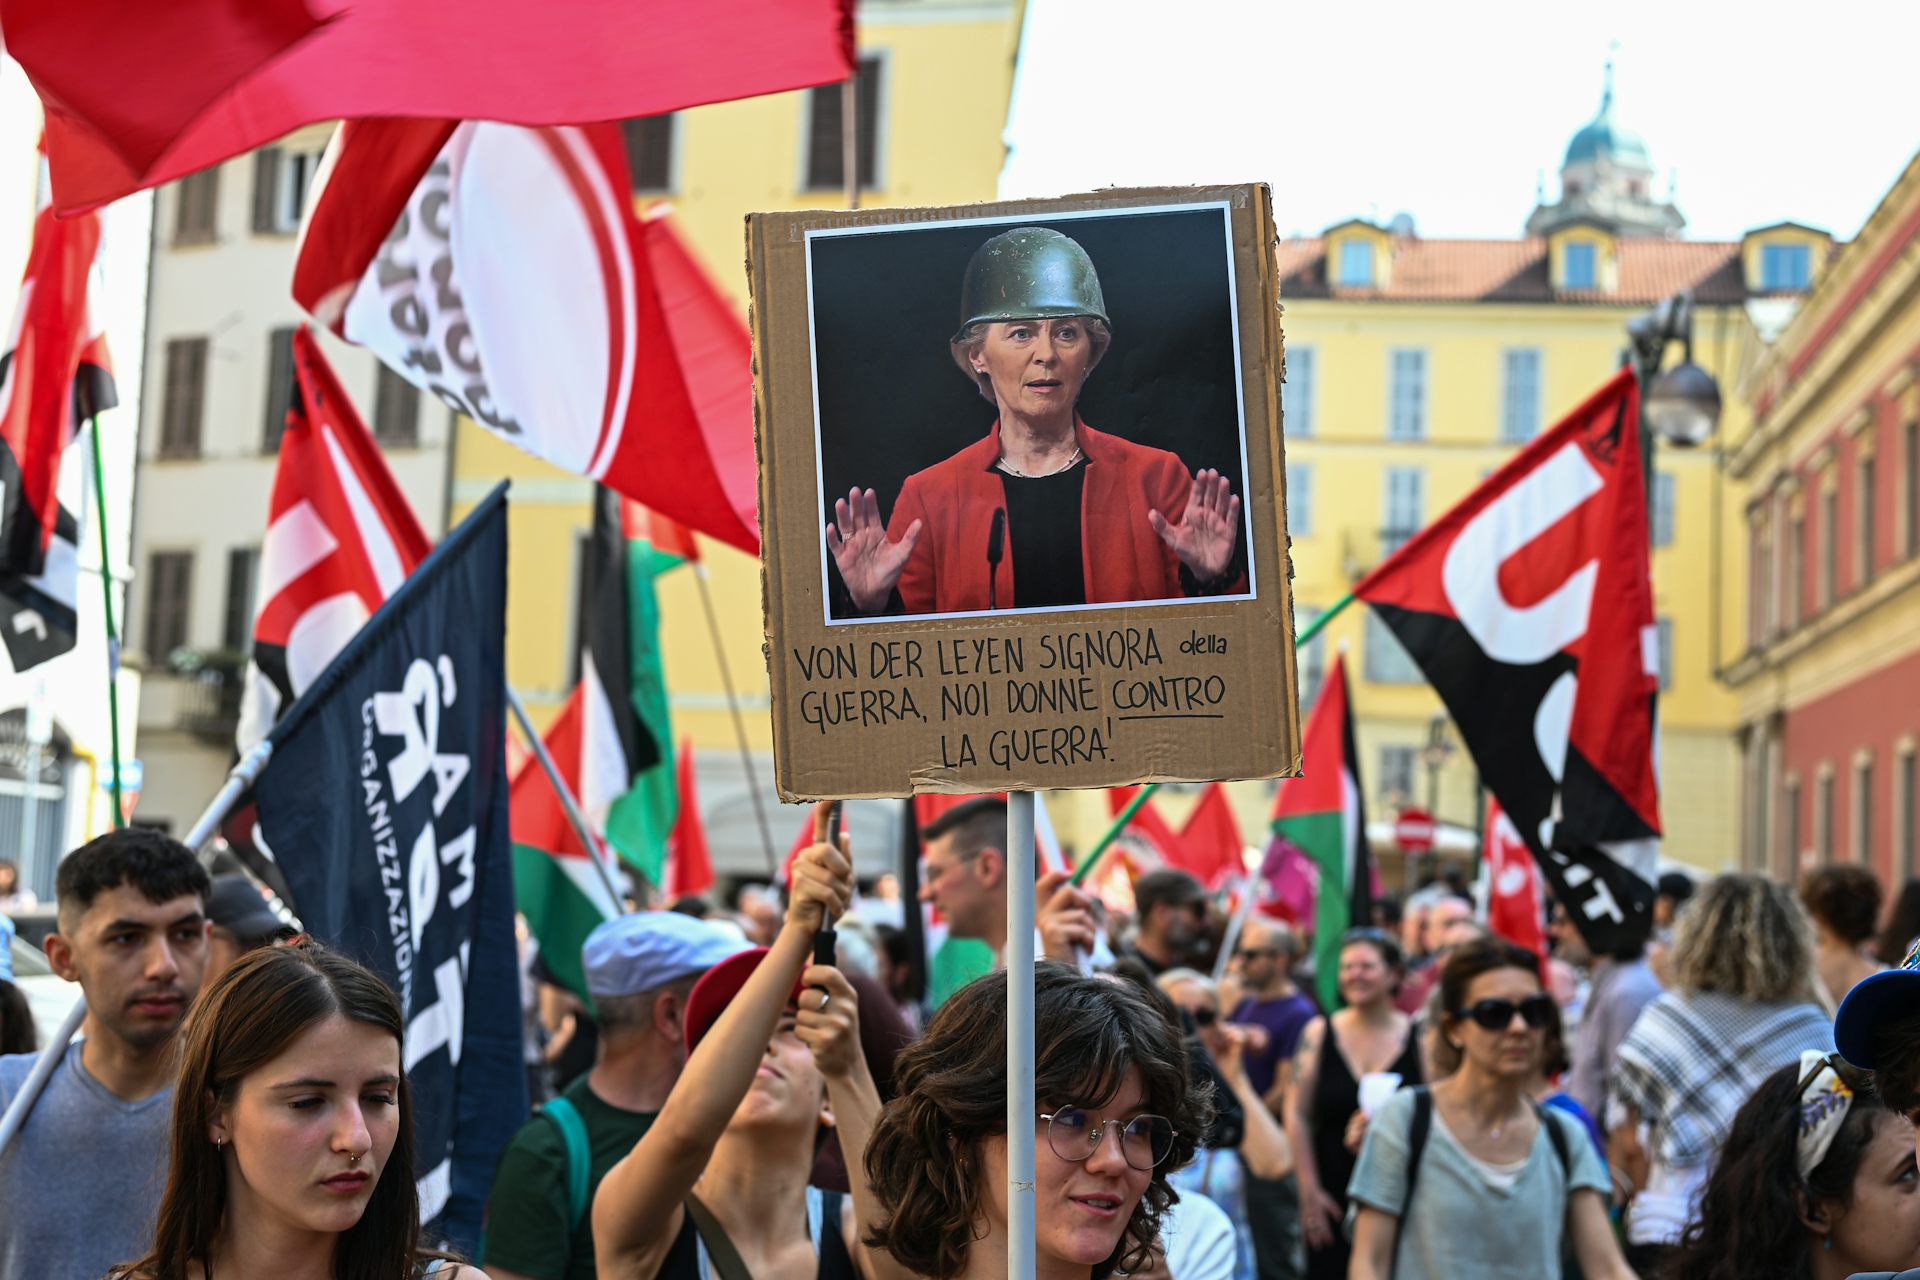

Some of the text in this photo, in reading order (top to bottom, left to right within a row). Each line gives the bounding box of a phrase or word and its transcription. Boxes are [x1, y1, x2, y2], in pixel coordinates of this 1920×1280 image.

[793, 627, 1229, 682] VON DER LEYEN SIGNORA della
[800, 673, 1227, 736] GUERRA, NOI DONNE CONTRO
[940, 715, 1116, 771] LA GUERRA!
